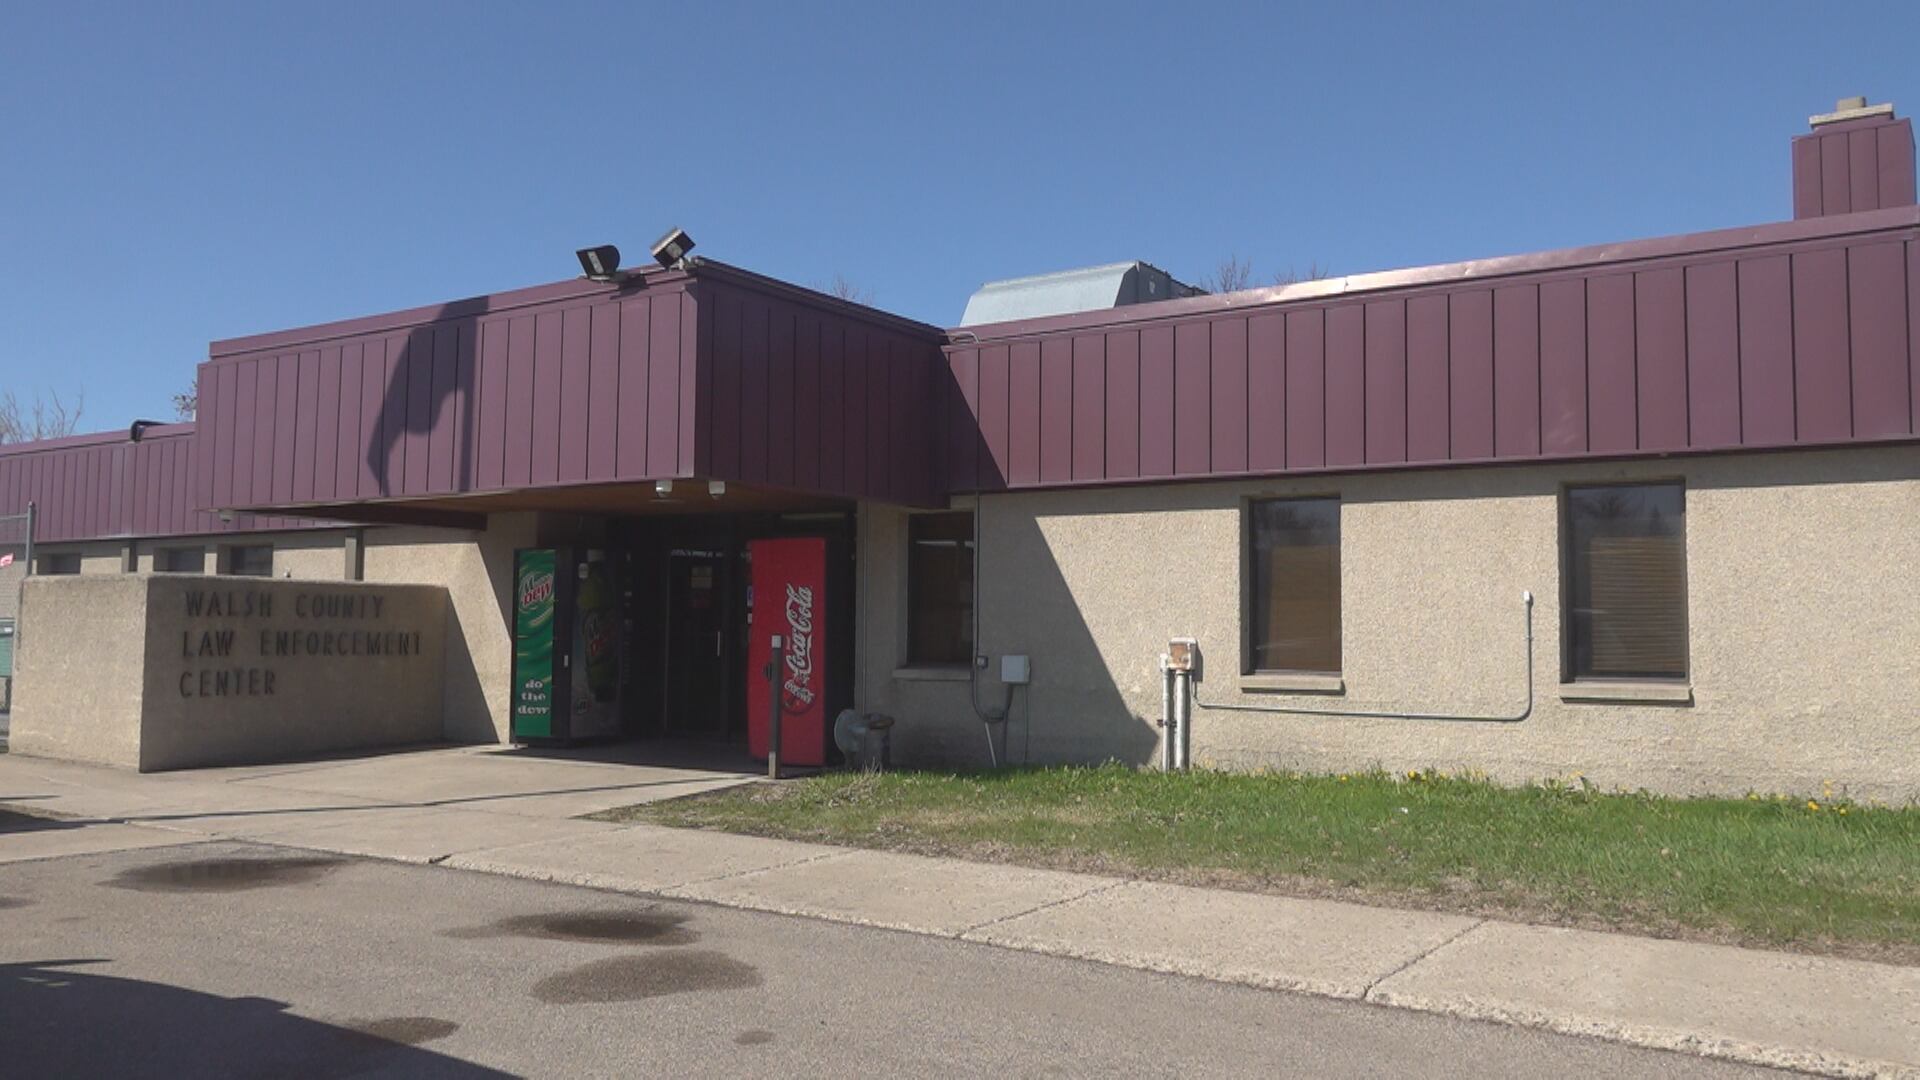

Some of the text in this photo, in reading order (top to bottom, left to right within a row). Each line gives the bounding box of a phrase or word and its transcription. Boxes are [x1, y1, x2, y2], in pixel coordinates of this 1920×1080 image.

[186, 591, 384, 618] WALSH COUNTY
[786, 583, 813, 674] Coca-Cola
[182, 630, 422, 657] LAW ENFORCEMENT
[180, 670, 276, 698] CENTER
[521, 692, 546, 701] the
[525, 679, 543, 689] do
[517, 704, 549, 714] dew
